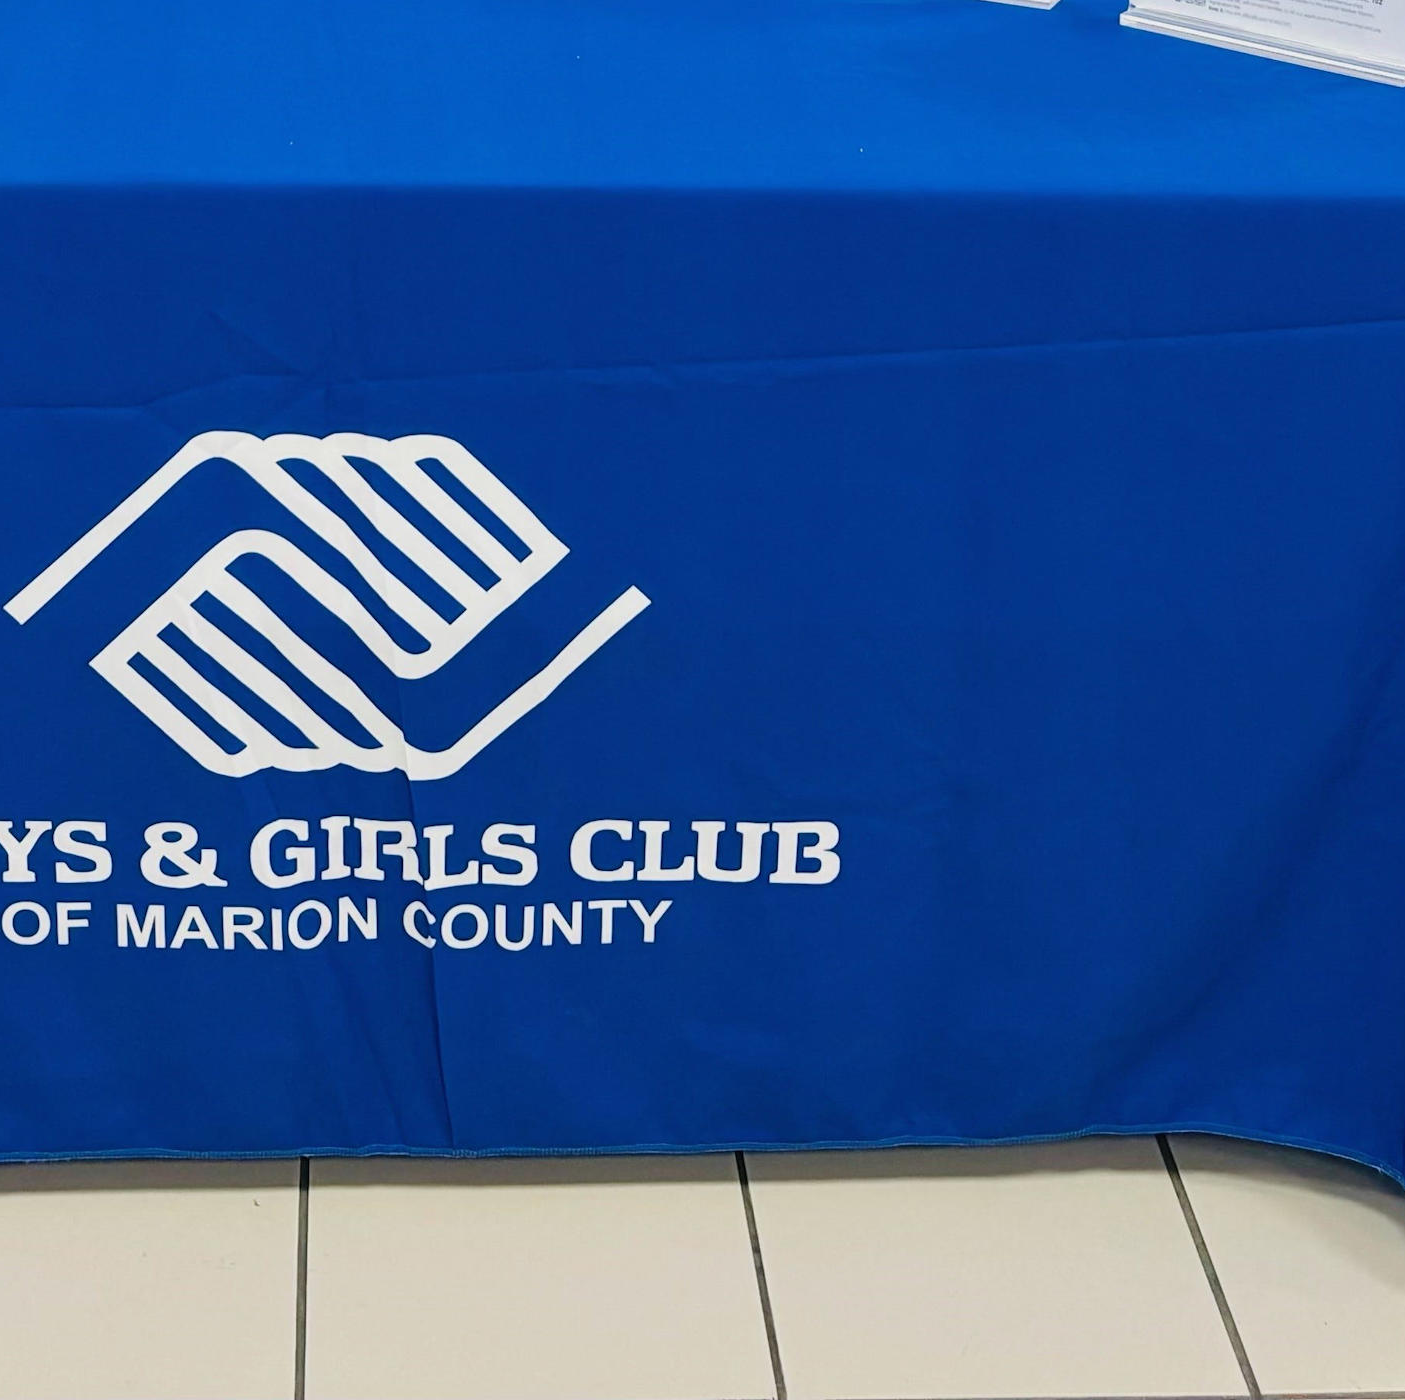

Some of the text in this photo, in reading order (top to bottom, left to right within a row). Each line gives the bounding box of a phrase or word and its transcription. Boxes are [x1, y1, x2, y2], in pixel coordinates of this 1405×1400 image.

[140, 821, 227, 890] &
[249, 815, 537, 891] GIRLS
[569, 819, 841, 885] CLUB
[0, 897, 672, 952] OF MARION COUNTY
